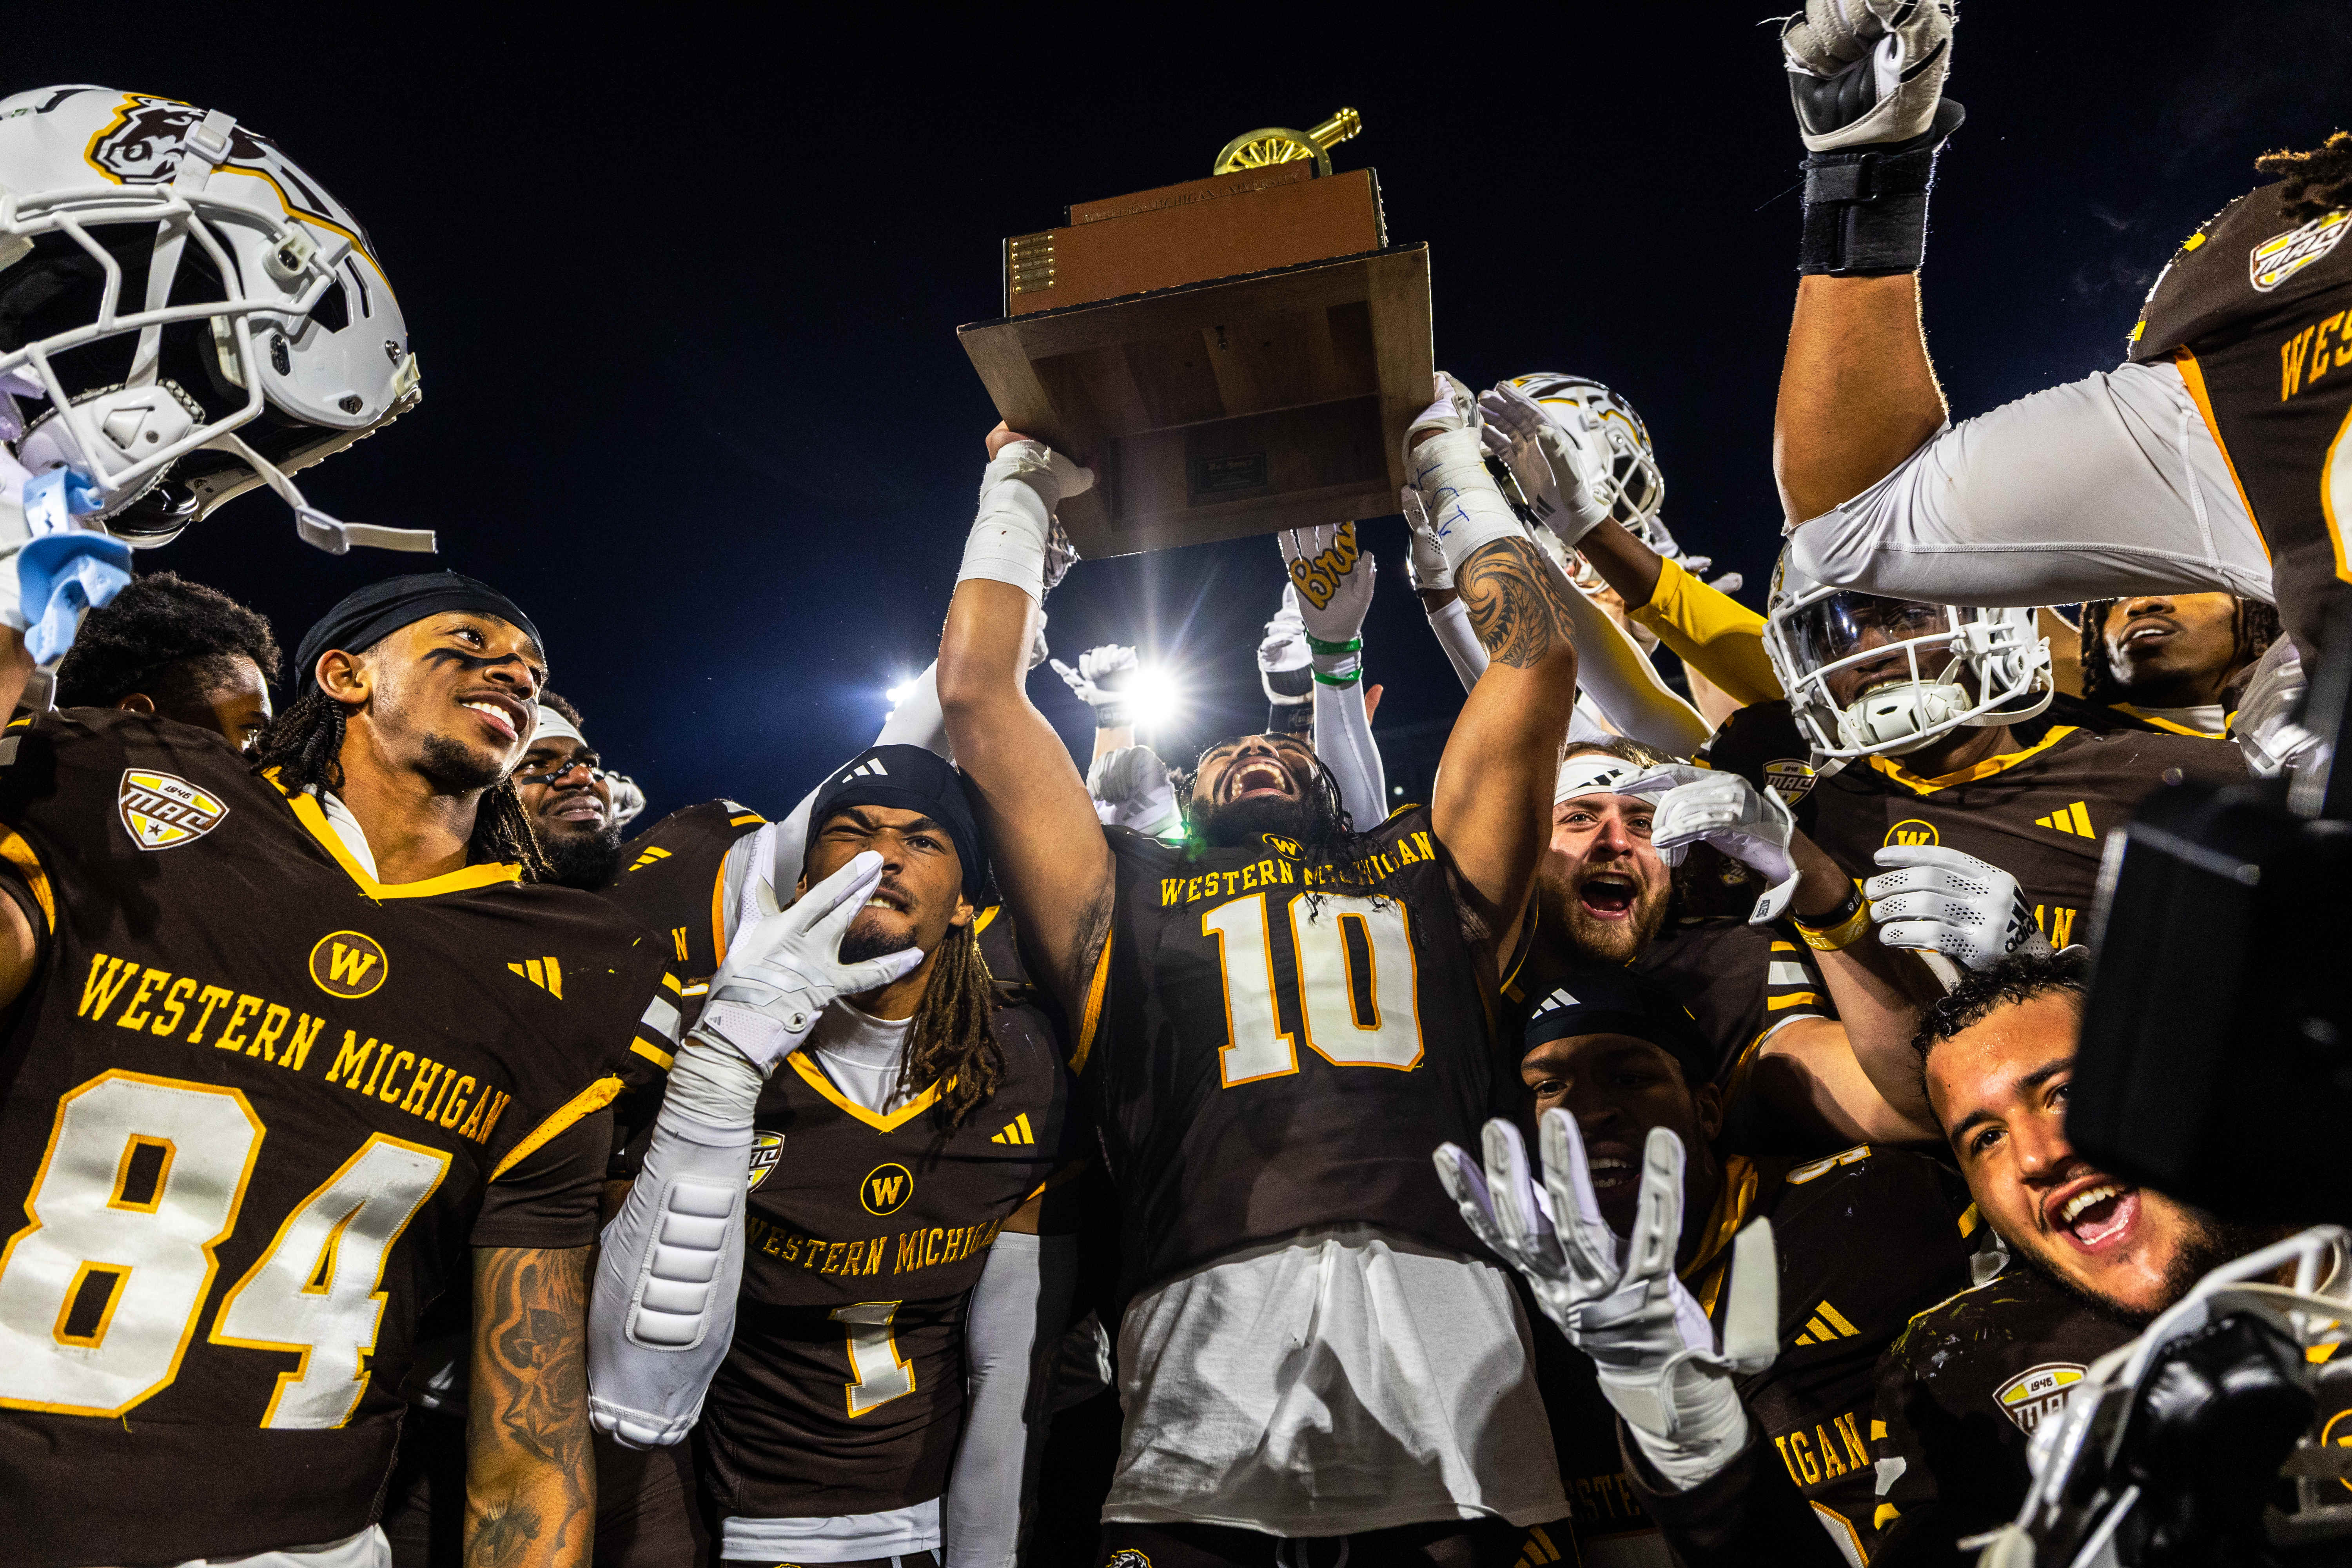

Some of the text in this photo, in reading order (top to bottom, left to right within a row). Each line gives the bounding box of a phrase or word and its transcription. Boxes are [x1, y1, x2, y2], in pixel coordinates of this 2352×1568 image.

[164, 786, 192, 799] 1946
[1766, 775, 1812, 789] MAC
[121, 787, 211, 833] MAC
[1270, 837, 1297, 856] W
[1161, 858, 1294, 907] WESTERN
[329, 941, 378, 987] W
[1201, 890, 1425, 1089] 10
[78, 953, 512, 1145] WESTERN MICHIGAN
[871, 1175, 904, 1207] W
[0, 1068, 453, 1429] 84
[745, 1215, 1002, 1276] WESTERN MICHIGA
[827, 1300, 916, 1419] 1
[2013, 1393, 2064, 1428] MA
